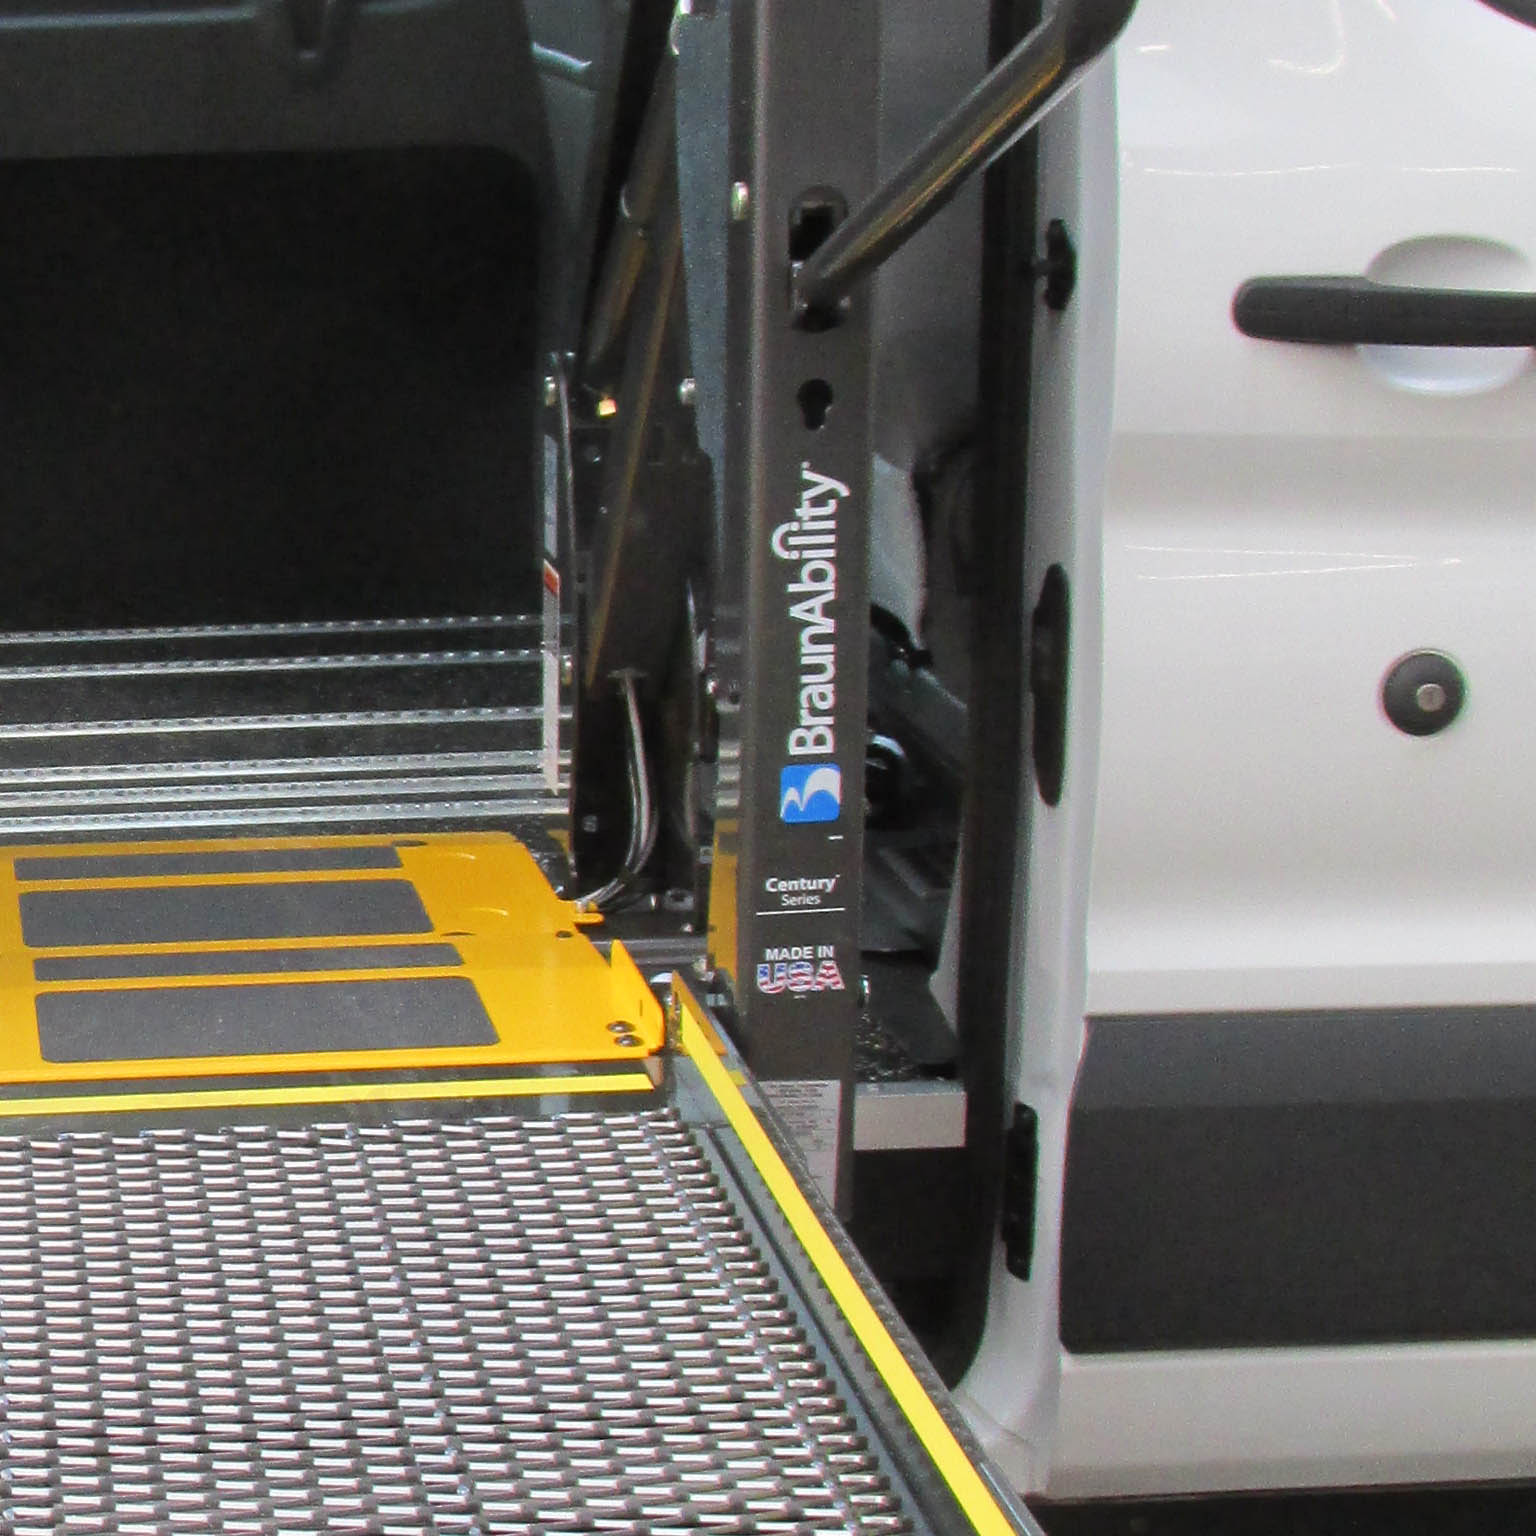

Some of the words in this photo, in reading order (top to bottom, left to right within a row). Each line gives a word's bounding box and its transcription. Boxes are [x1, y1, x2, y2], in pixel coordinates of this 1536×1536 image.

[771, 465, 851, 756] BraunAbility
[765, 876, 837, 893] Century
[780, 893, 822, 906] Series
[765, 945, 814, 961] MADE
[817, 944, 835, 959] IN
[756, 959, 847, 995] USA
